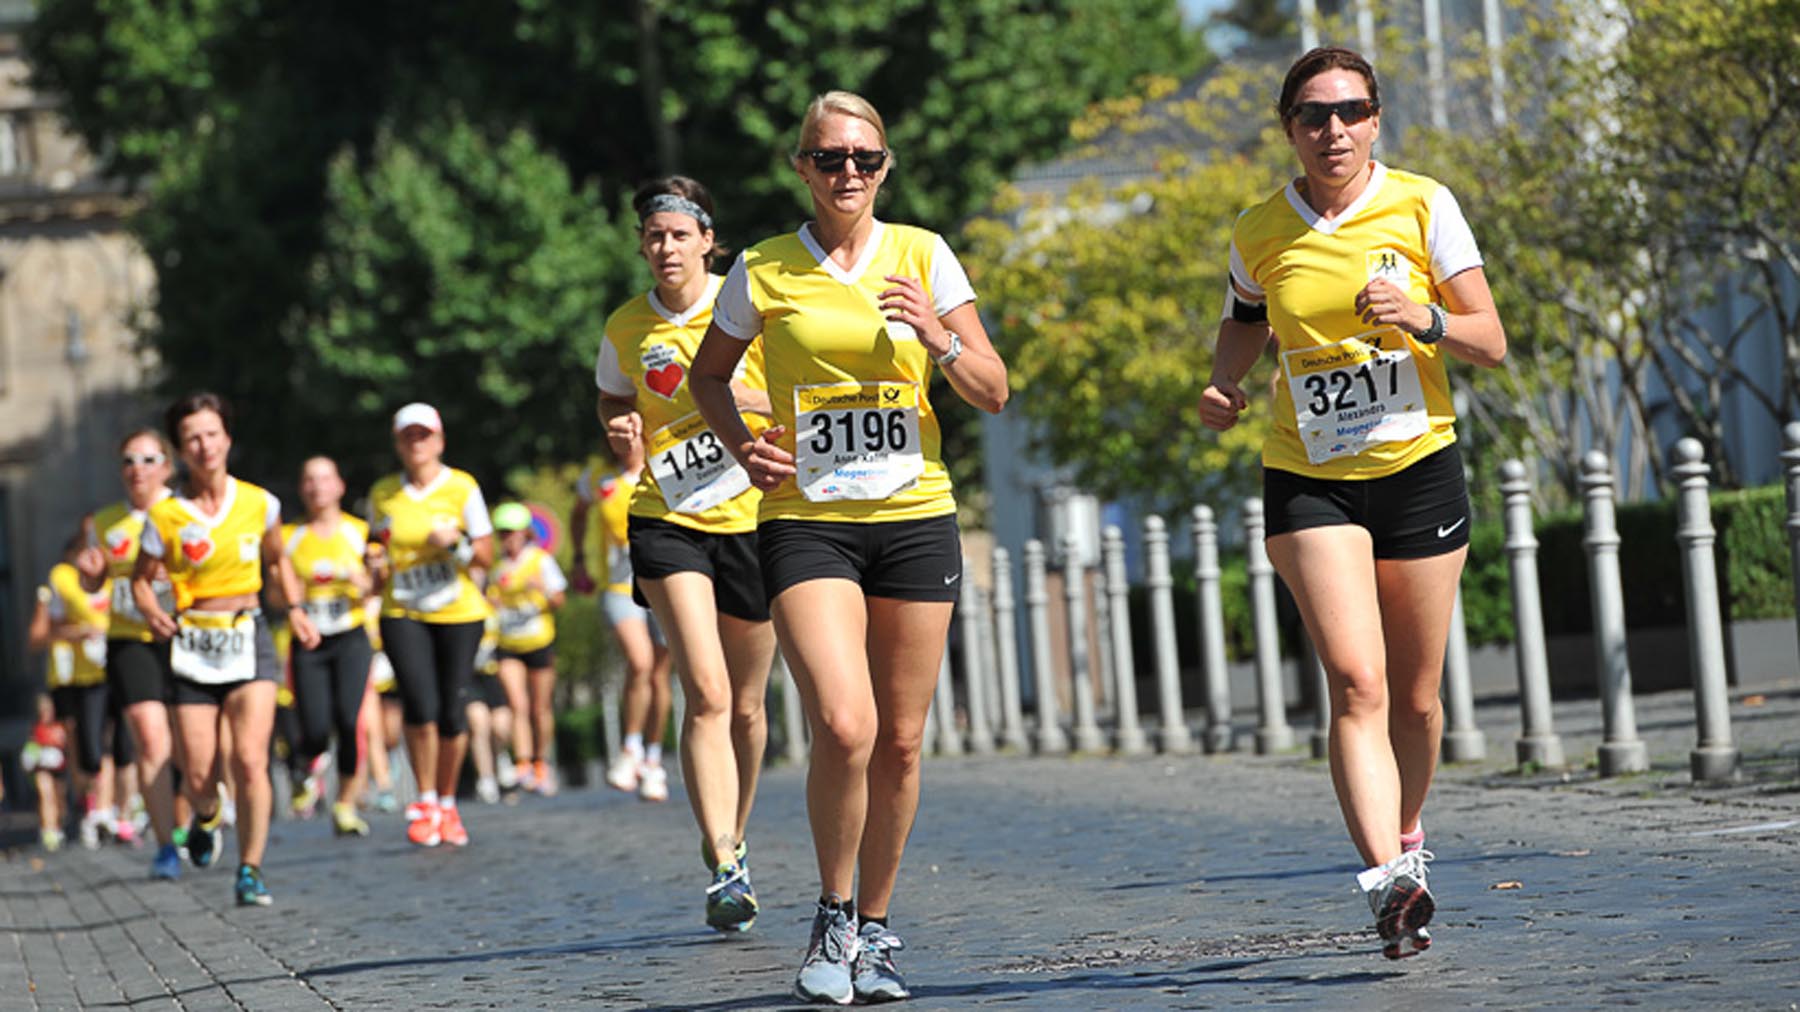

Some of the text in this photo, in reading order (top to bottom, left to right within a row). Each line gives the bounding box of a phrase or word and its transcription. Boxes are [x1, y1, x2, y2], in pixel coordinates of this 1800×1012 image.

[1304, 357, 1399, 417] 3217
[810, 410, 907, 454] 3196
[1337, 403, 1386, 422] Alexandra
